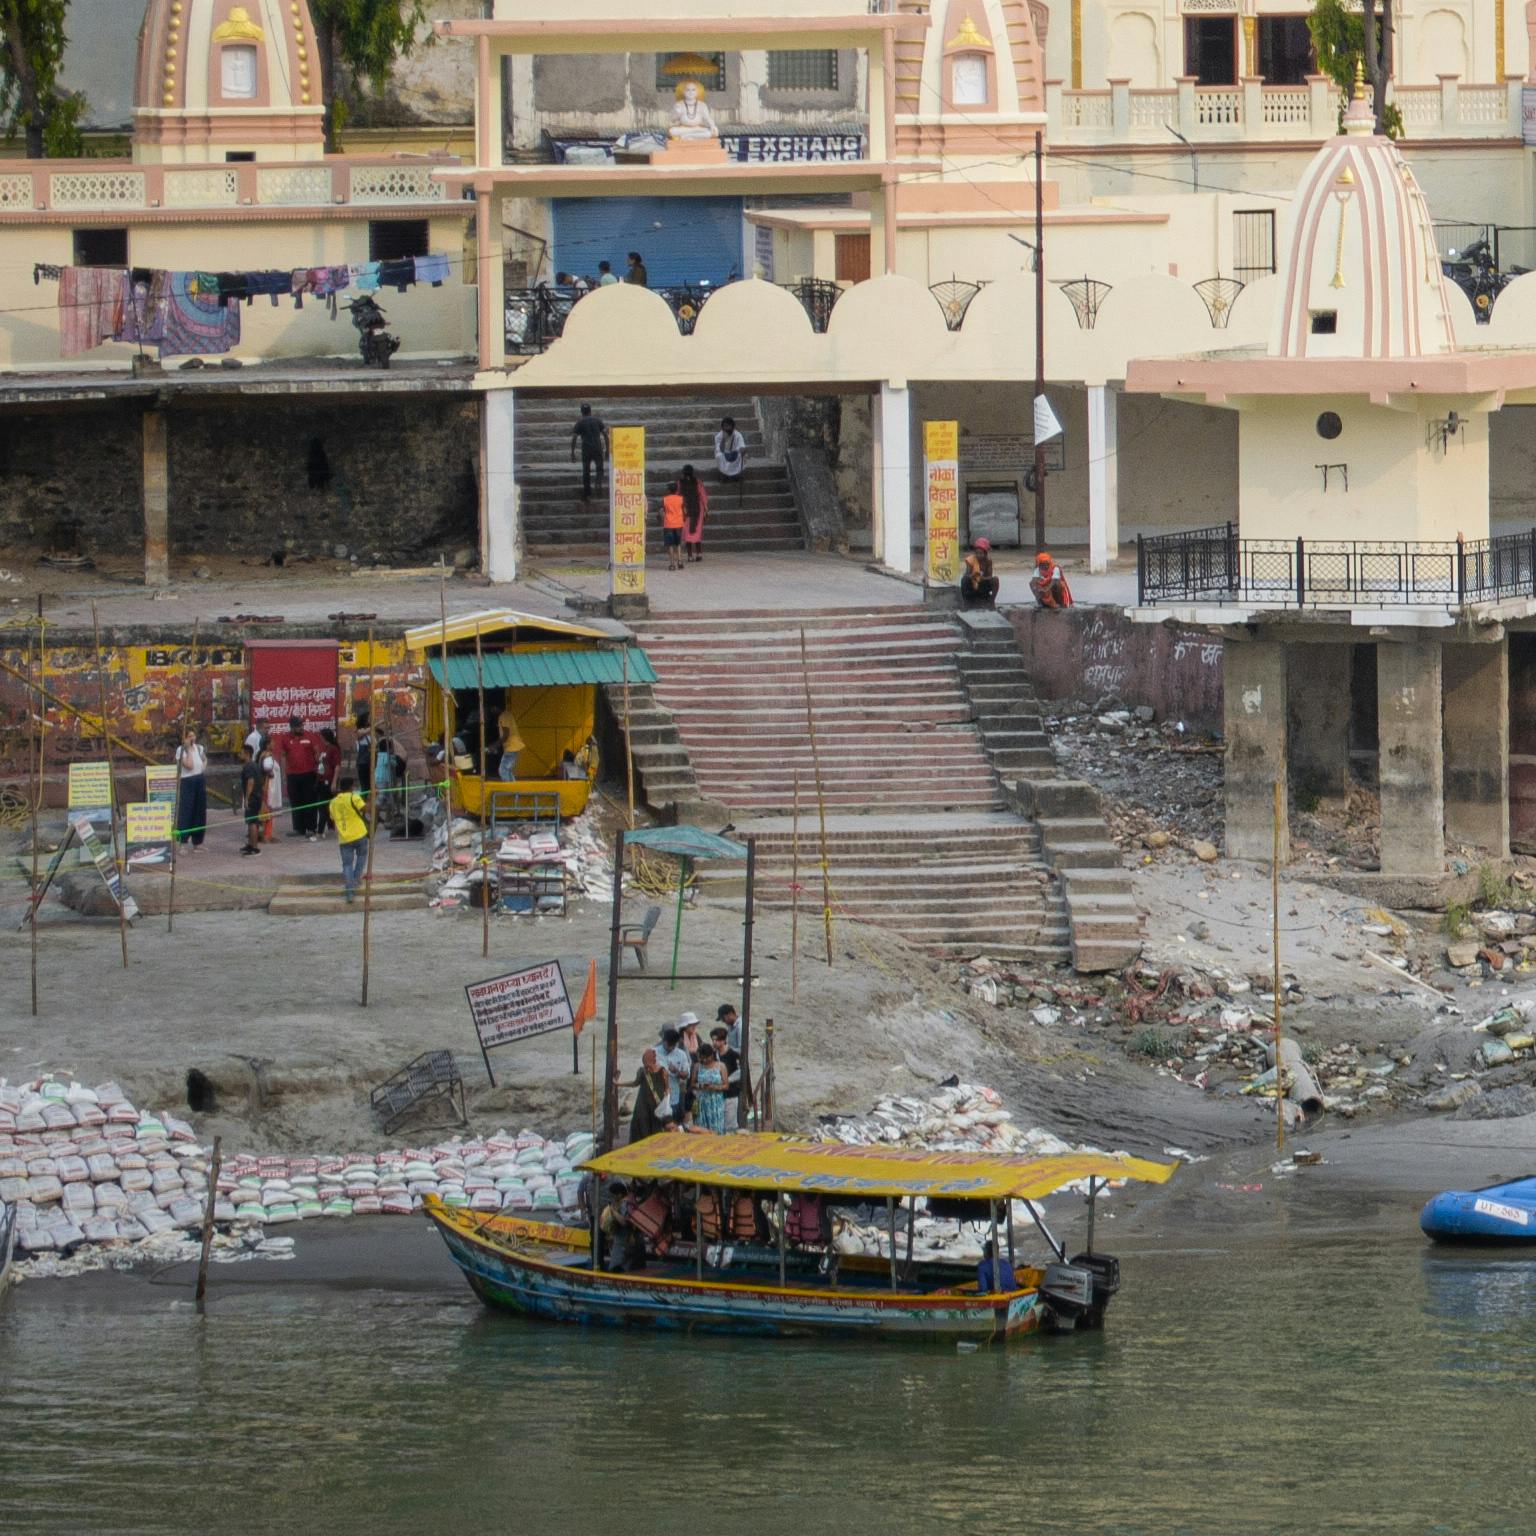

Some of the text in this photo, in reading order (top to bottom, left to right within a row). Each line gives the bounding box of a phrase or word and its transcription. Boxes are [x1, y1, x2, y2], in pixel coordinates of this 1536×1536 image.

[748, 136, 864, 152] EXCHANG
[614, 492, 642, 509] विहार
[928, 487, 957, 504] विहार
[621, 512, 636, 526] का
[934, 508, 951, 522] का
